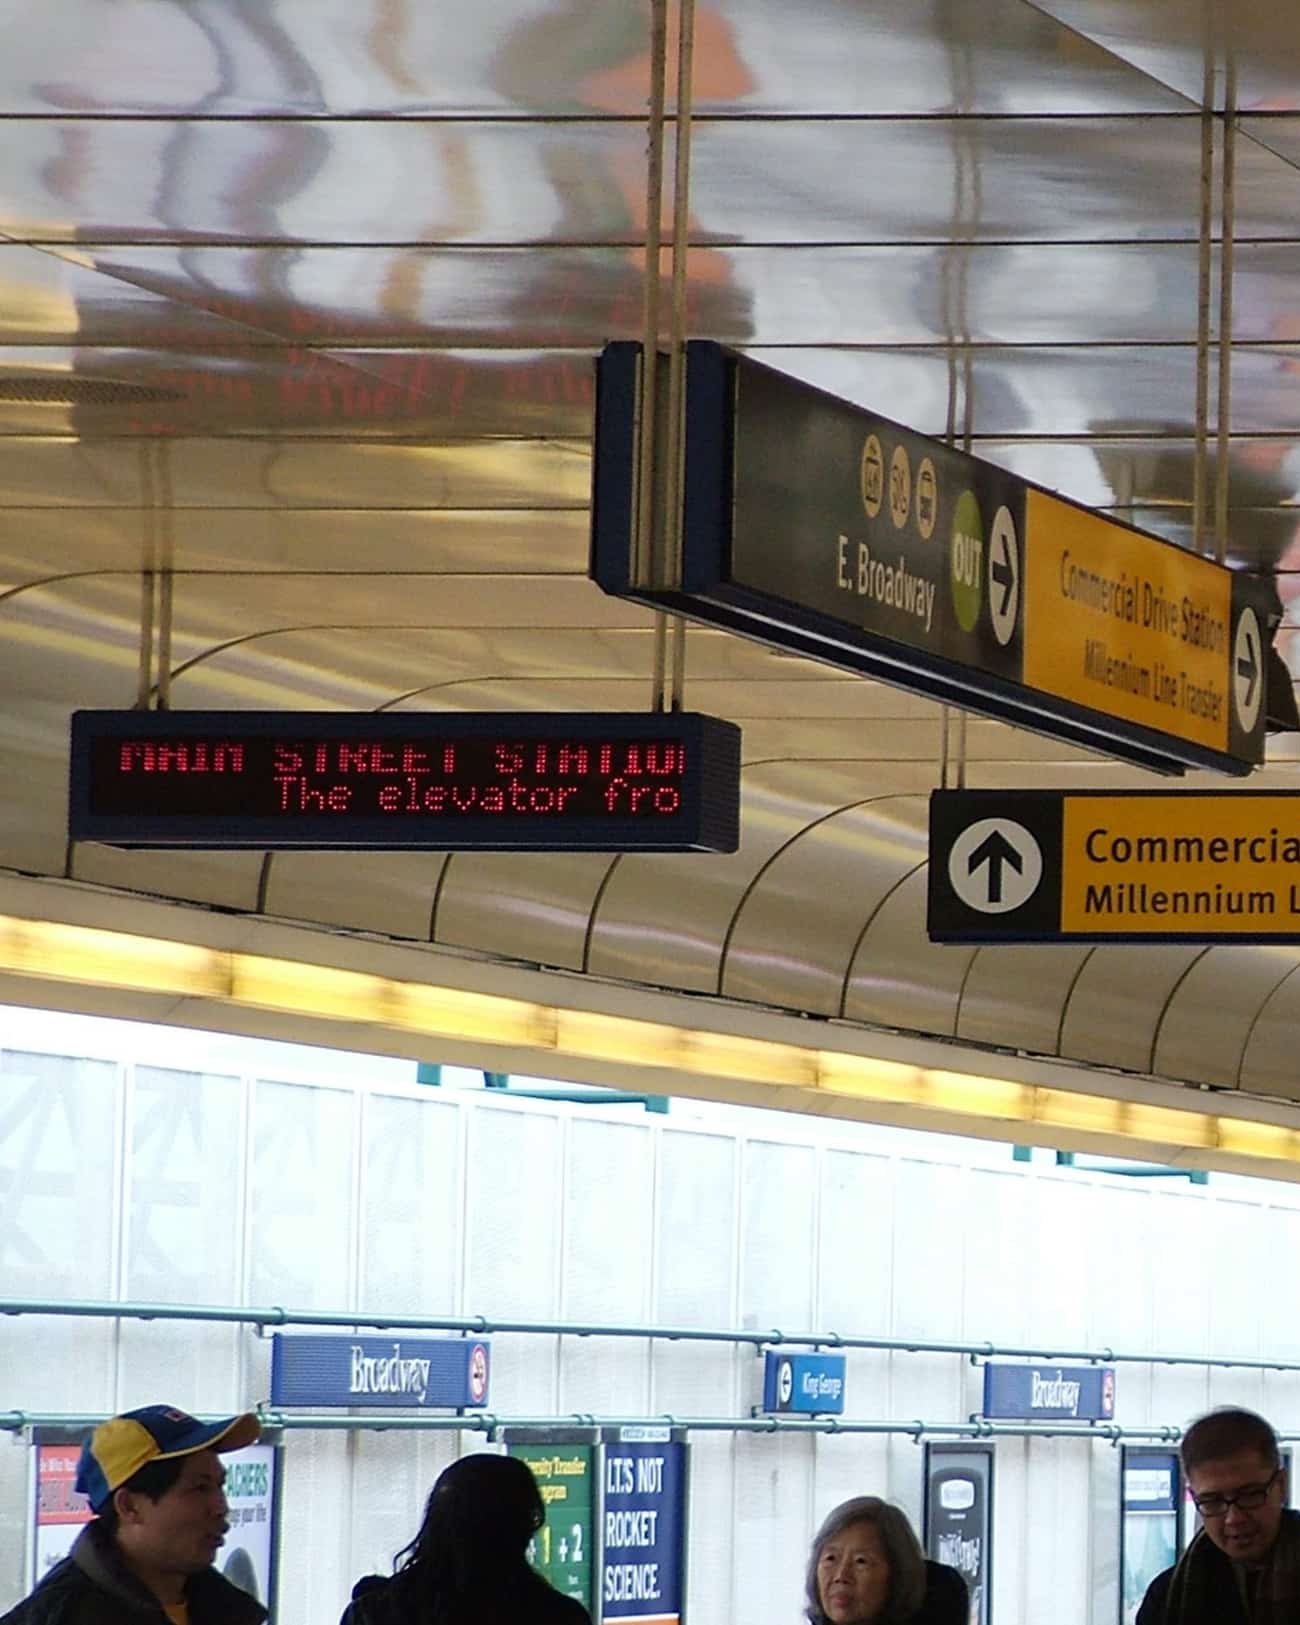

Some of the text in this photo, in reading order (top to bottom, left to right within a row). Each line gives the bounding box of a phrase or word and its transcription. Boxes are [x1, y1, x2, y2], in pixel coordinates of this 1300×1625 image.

[952, 532, 983, 589] OUT
[837, 534, 936, 633] E. Broadway
[1060, 550, 1224, 655] Commercial Drive Station
[1084, 639, 1222, 721] Millennium Line Transfer
[273, 776, 679, 812] The elevator fro
[1084, 883, 1275, 914] Millennium
[350, 1343, 431, 1403] Broadway
[803, 1372, 842, 1400] King George
[1030, 1370, 1080, 1416] Broadway
[638, 1457, 664, 1493] NOT
[572, 1523, 583, 1562] 2
[606, 1511, 657, 1548] ROCKET
[606, 1564, 661, 1601] SCIENCE.
